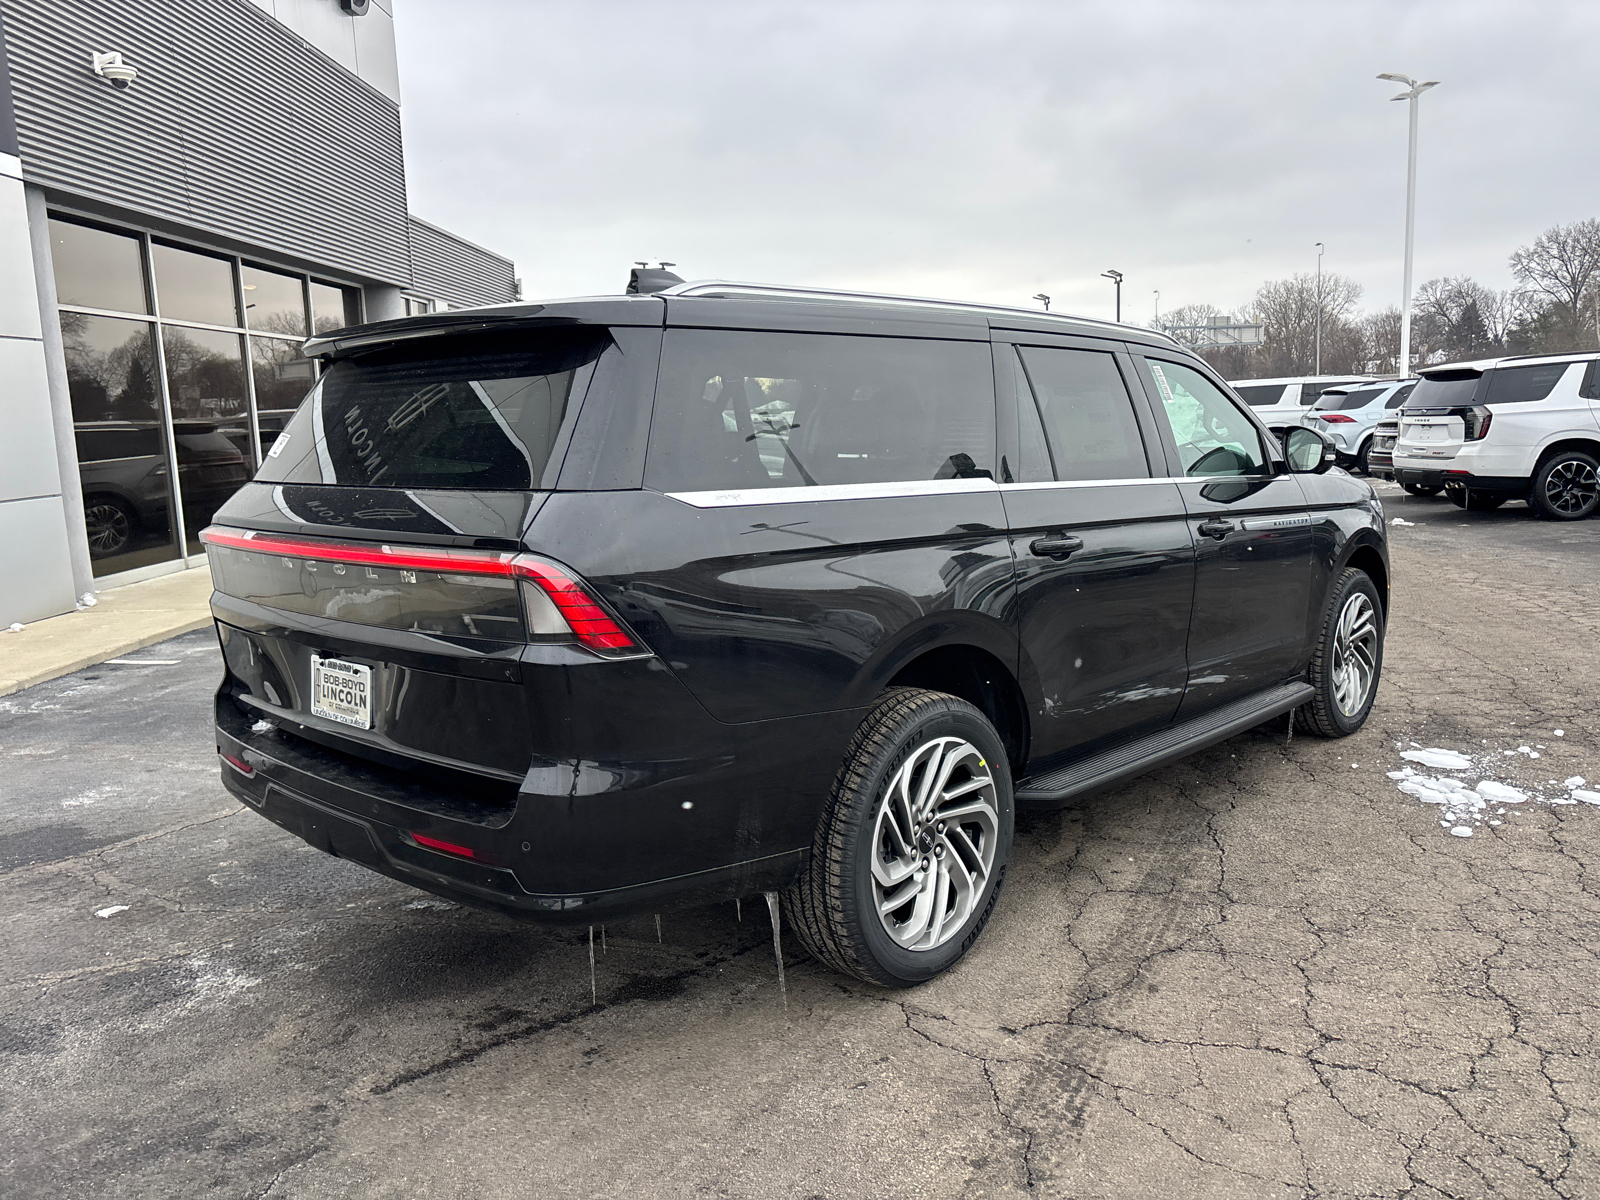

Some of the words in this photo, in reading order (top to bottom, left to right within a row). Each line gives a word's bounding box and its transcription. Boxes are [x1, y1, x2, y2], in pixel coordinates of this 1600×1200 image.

[1273, 518, 1308, 526] NAVIGATOR
[324, 674, 365, 692] BOB-BOYD
[323, 684, 366, 709] LINCOLN
